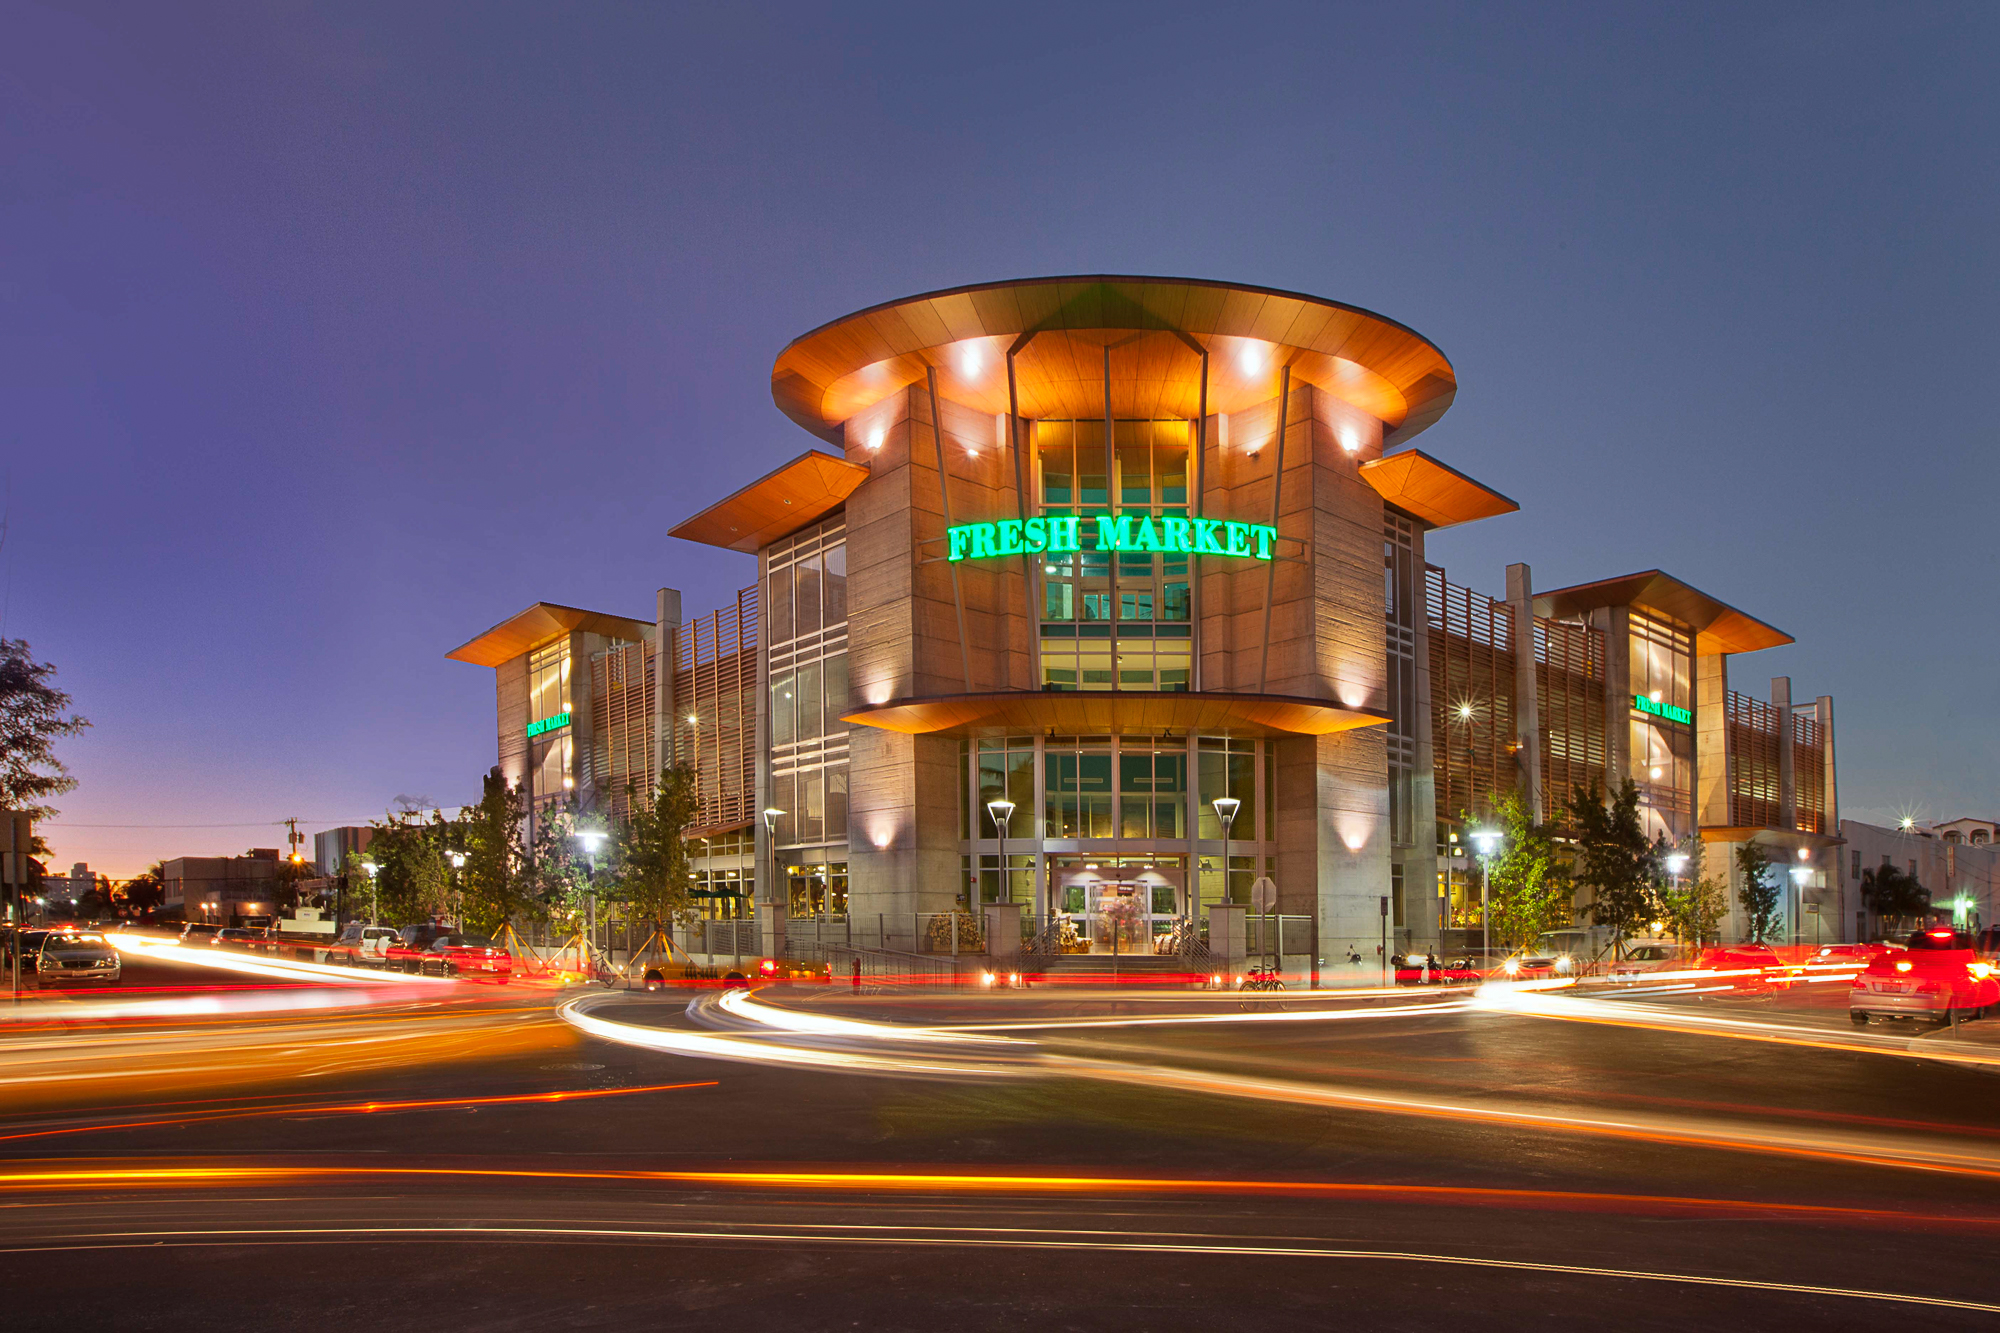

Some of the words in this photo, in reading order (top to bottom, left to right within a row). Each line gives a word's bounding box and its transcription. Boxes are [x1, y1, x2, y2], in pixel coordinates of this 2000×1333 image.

[947, 515, 1082, 563] FRESH
[1095, 515, 1277, 561] MARKET
[1635, 694, 1661, 716] FRESH
[1661, 702, 1692, 725] MARKET
